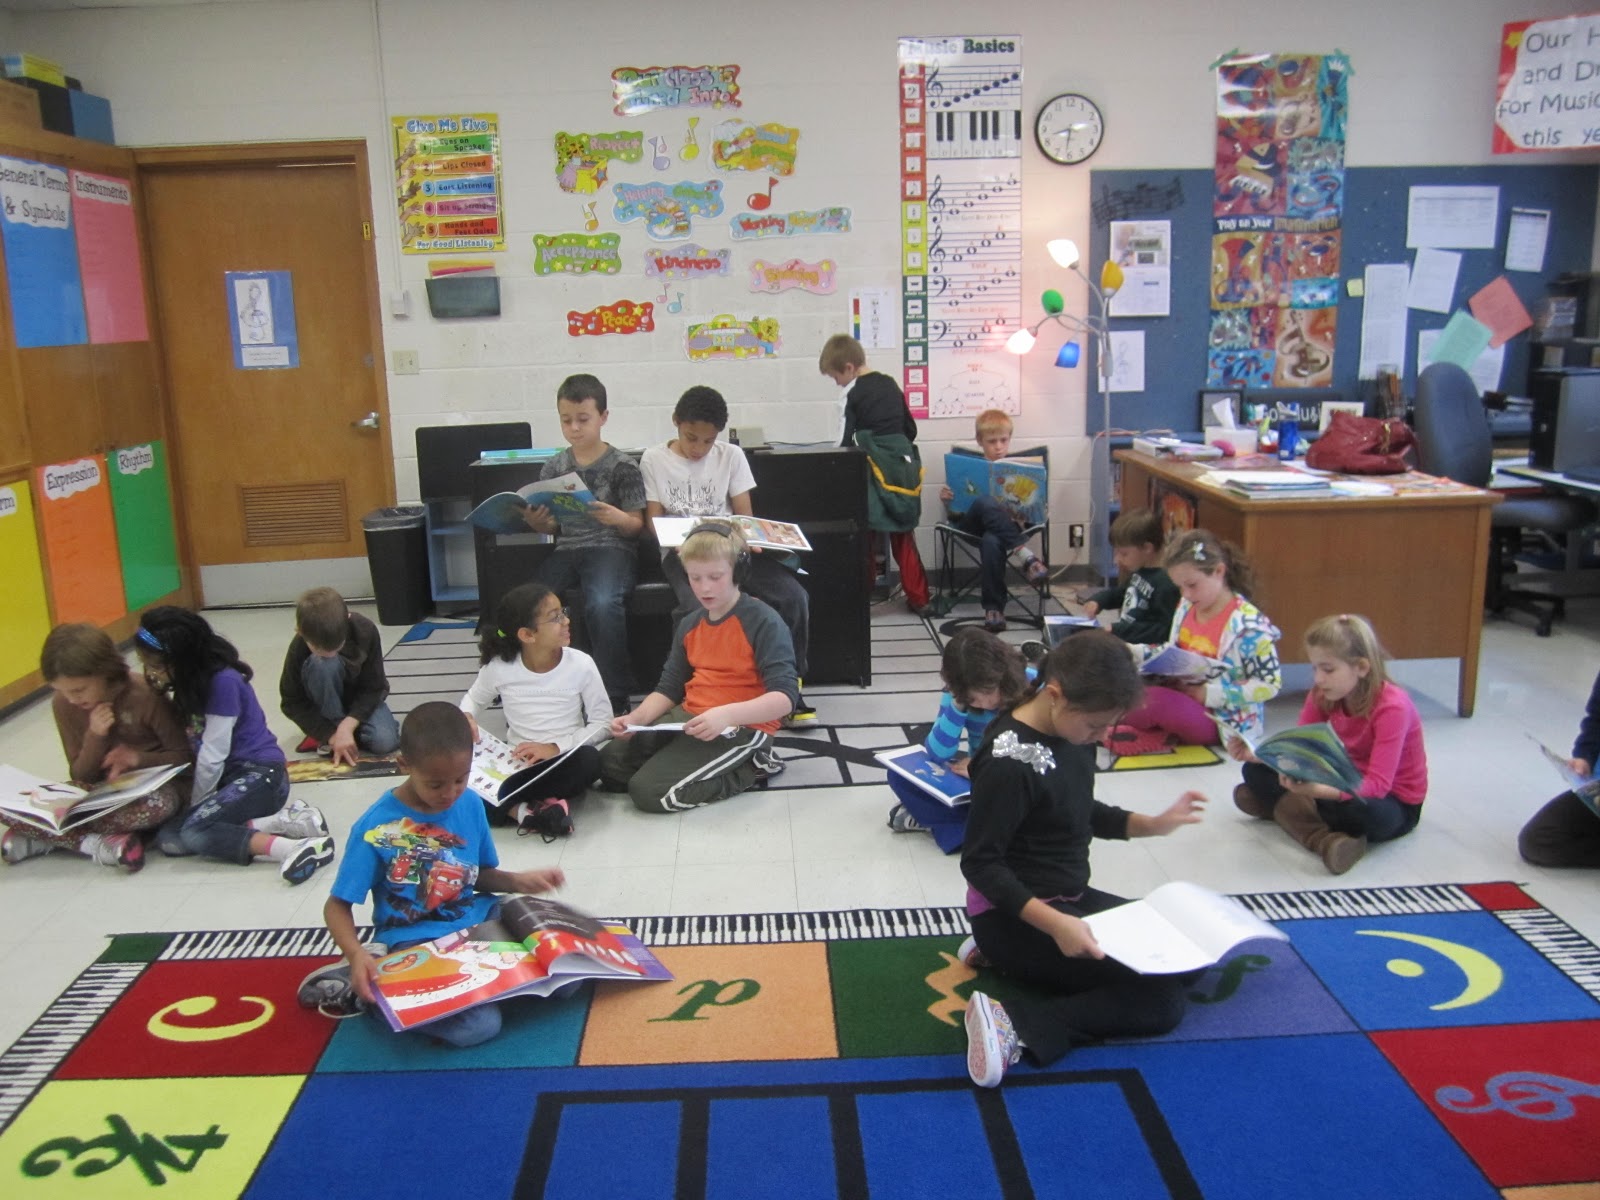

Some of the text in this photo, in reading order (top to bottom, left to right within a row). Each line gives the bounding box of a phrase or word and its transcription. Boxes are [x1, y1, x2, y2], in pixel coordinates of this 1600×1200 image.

[963, 38, 1015, 54] Basics
[1526, 33, 1572, 53] Our
[1523, 63, 1562, 85] and
[1497, 100, 1531, 118] for
[407, 117, 490, 133] Give Me Five
[1522, 127, 1563, 147] this
[0, 164, 70, 192] eneral Terms
[75, 175, 128, 201] Instruments
[457, 181, 492, 190] Listening
[22, 199, 66, 223] Symbols
[654, 256, 721, 273] Kindness
[601, 310, 636, 328] Peace
[119, 451, 153, 471] Rhythm
[46, 464, 98, 491] Expression
